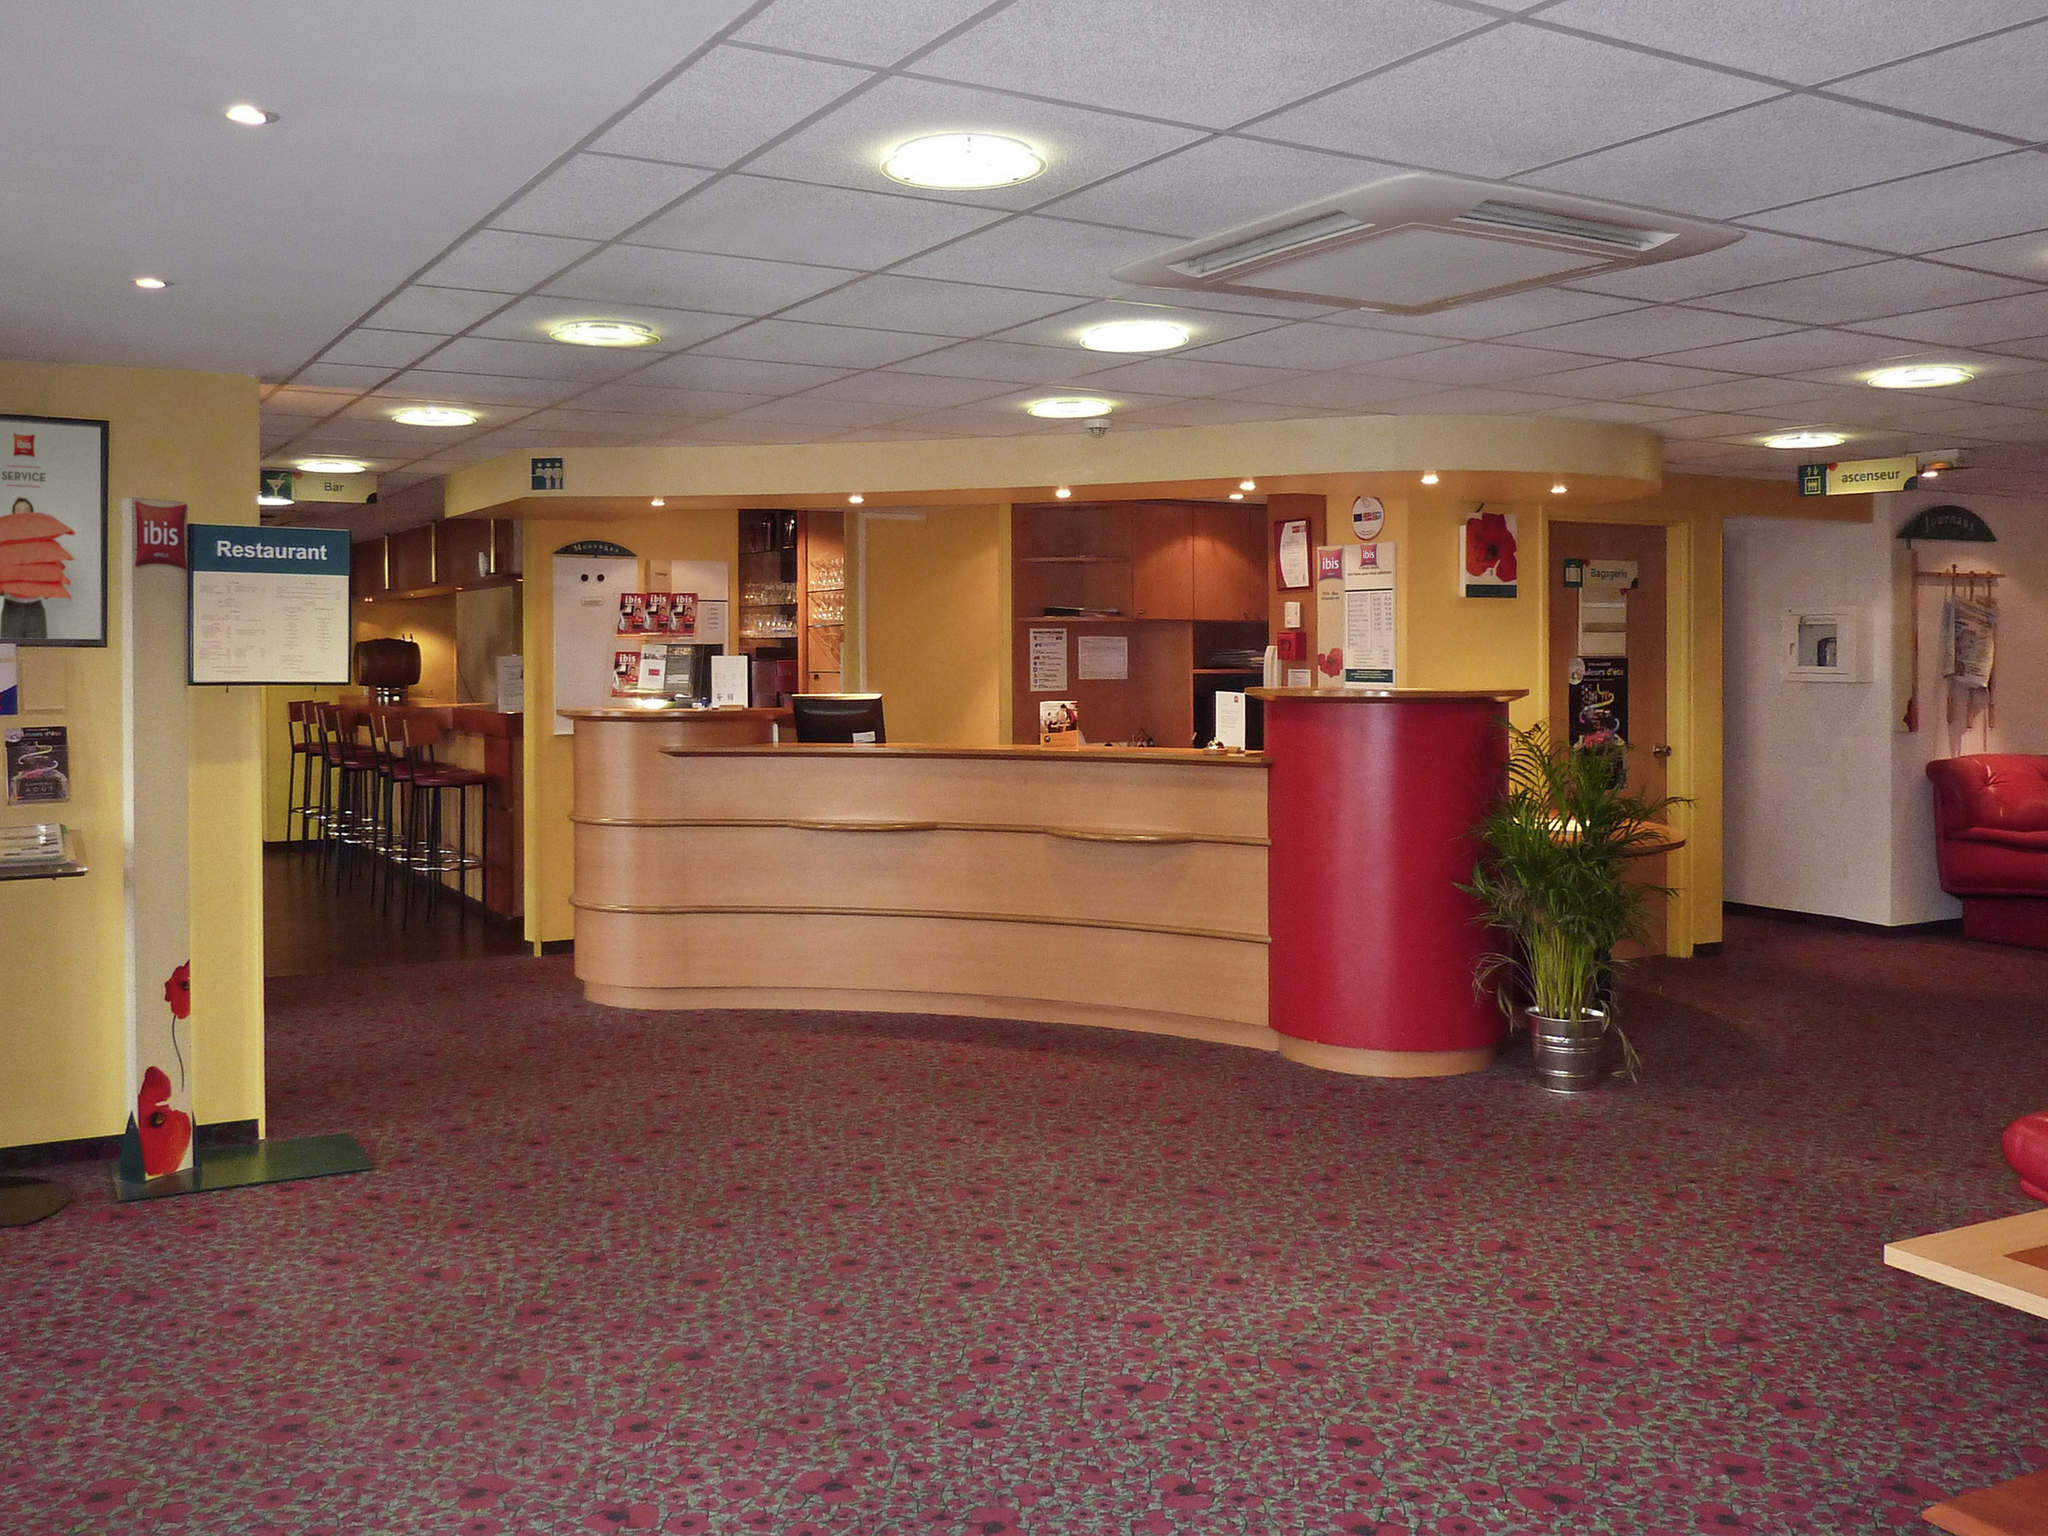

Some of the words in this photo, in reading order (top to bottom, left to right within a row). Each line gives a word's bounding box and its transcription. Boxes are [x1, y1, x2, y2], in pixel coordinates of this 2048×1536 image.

[1, 471, 47, 482] SERVICE
[1841, 470, 1900, 484] ascenseur
[324, 481, 345, 492] Bar
[143, 520, 179, 546] ibis
[216, 540, 328, 561] Restaurant
[1361, 550, 1376, 560] ibis
[1321, 557, 1341, 571] ibis
[625, 595, 642, 604] ibis
[650, 594, 667, 604] ibis
[676, 595, 693, 604] ibis
[619, 654, 637, 663] ibis
